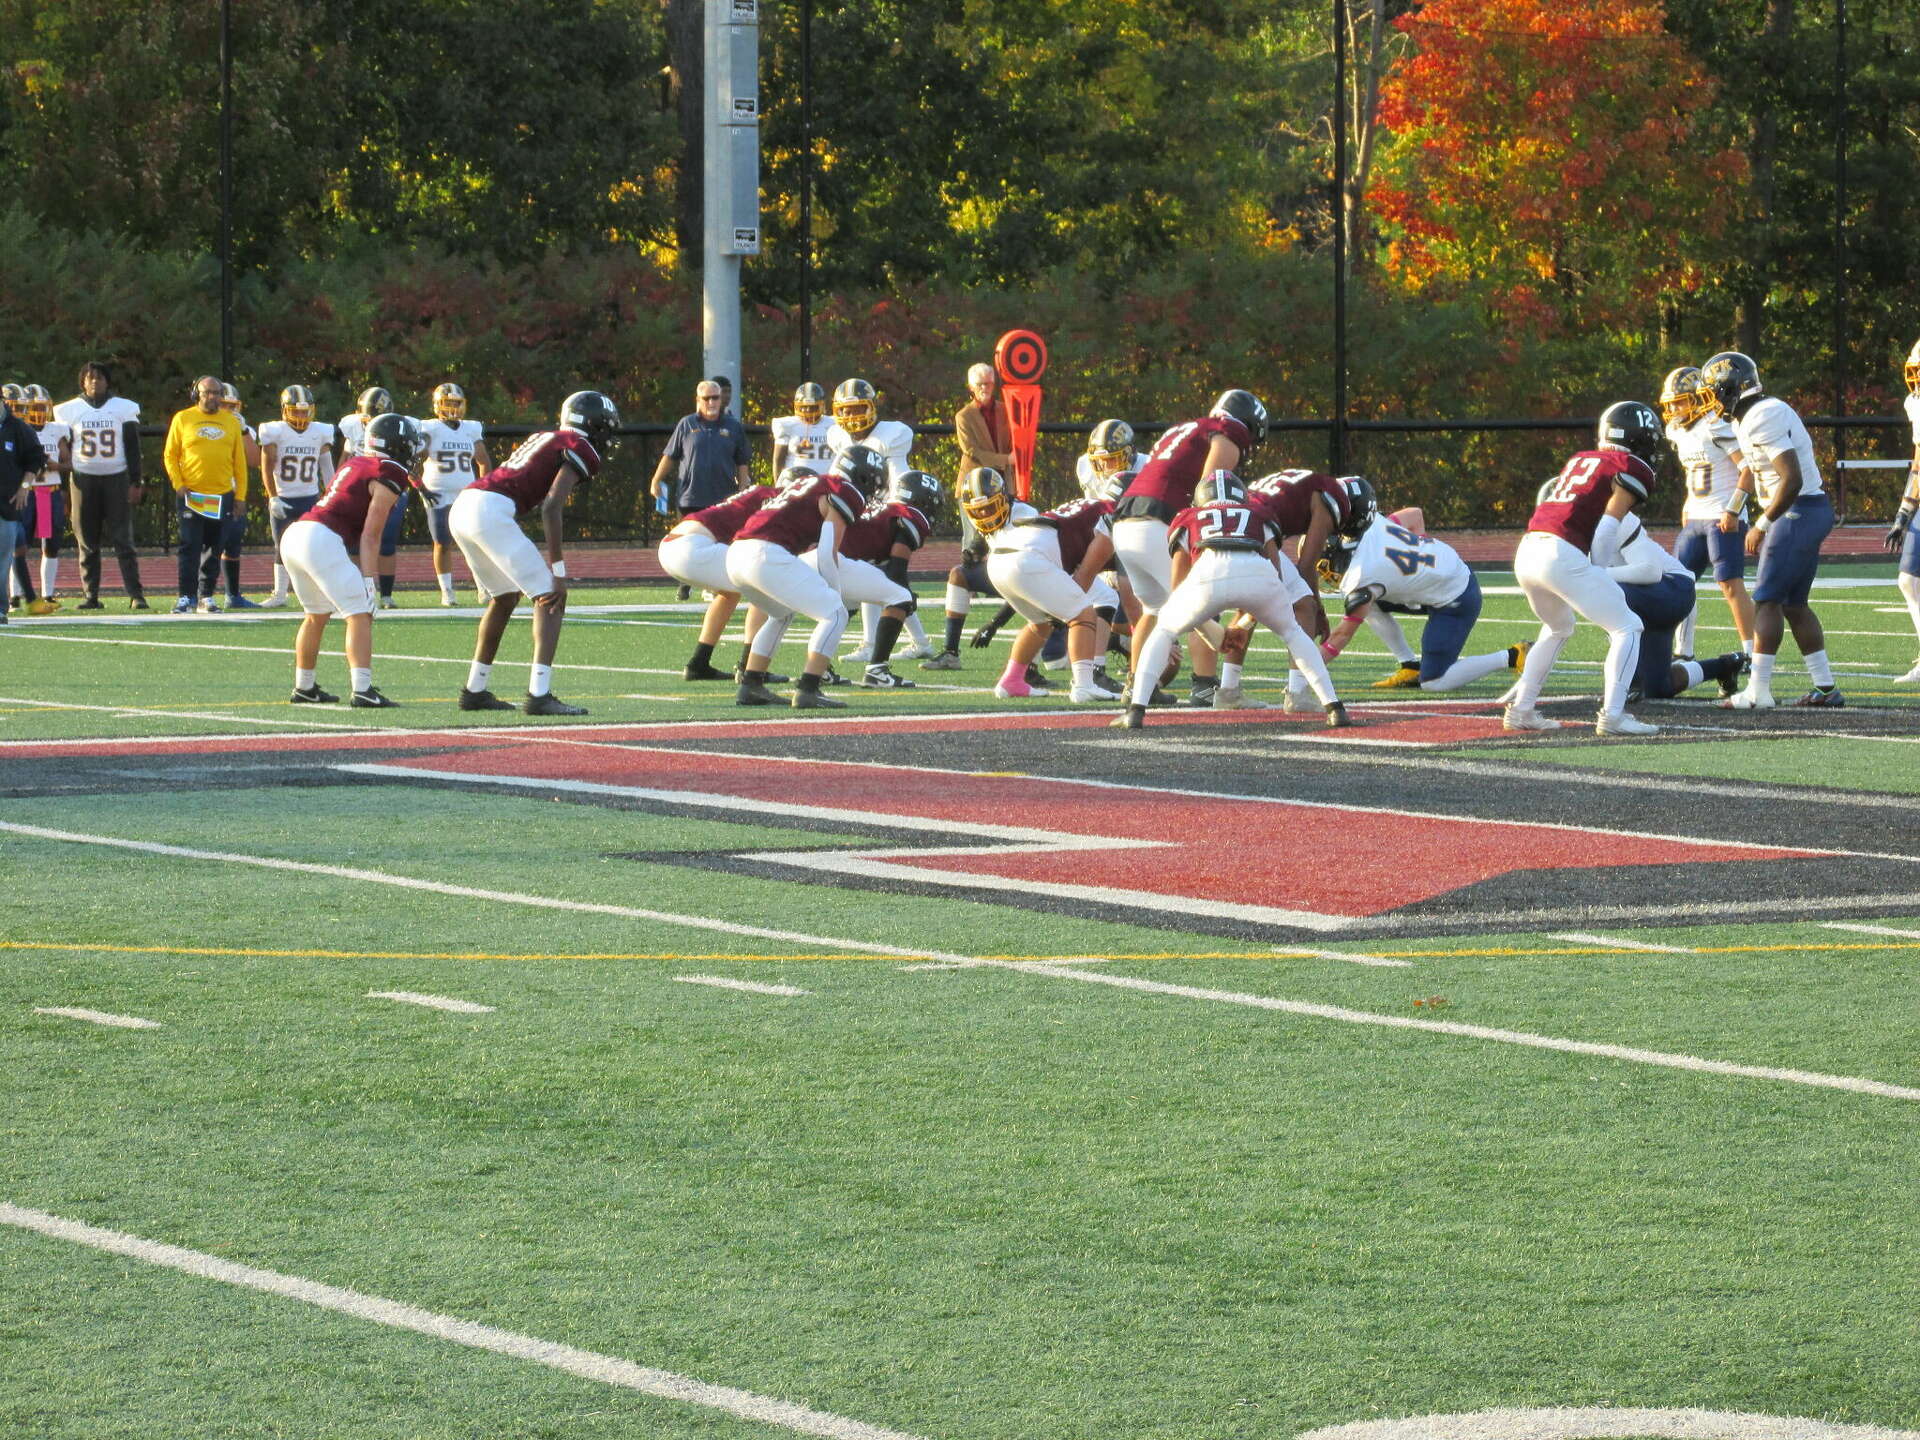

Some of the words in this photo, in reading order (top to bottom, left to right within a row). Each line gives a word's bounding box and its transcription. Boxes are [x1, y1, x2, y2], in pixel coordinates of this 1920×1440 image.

[82, 420, 113, 428] KENNEDY
[1636, 410, 1655, 428] 12
[81, 429, 115, 458] 69
[285, 446, 315, 454] KENNEDY
[280, 456, 316, 482] 60
[1544, 457, 1600, 503] 12
[1197, 508, 1250, 539] 27
[1385, 525, 1436, 576] 44
